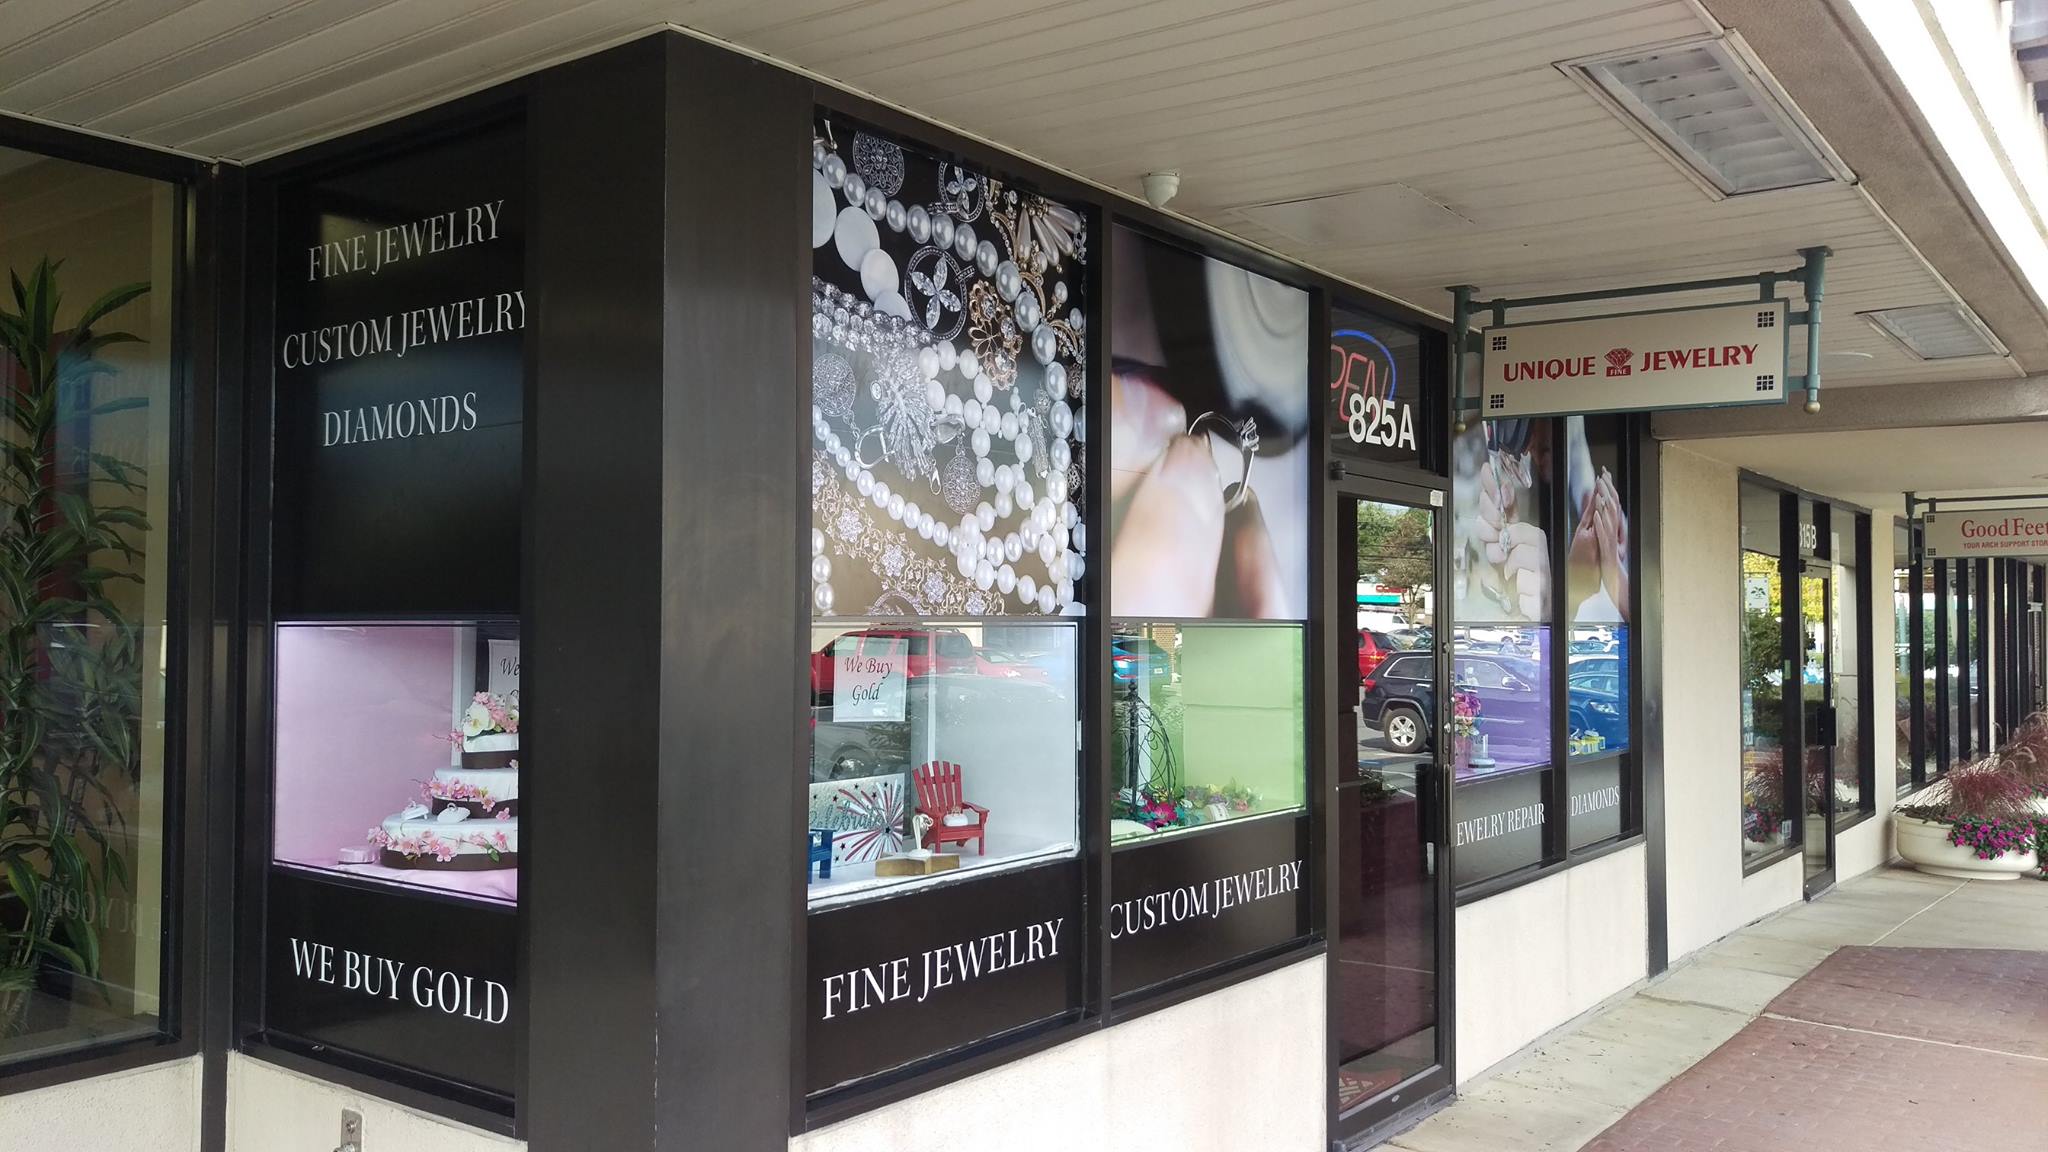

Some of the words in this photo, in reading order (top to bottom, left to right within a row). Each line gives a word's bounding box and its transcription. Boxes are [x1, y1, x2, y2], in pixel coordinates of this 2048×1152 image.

[308, 235, 367, 282] FINE
[371, 200, 504, 276] JEWELRY
[283, 315, 393, 369] CUSTOM
[397, 290, 527, 358] JEWELRY
[1331, 344, 1389, 421] PEN
[1503, 356, 1596, 382] UNIQUE
[1640, 344, 1759, 372] JEWELRY
[322, 391, 477, 447] DIAMONDS
[1348, 393, 1416, 451] 825A
[1961, 519, 2009, 538] Good
[2000, 540, 2029, 548] SUPPORT
[2031, 539, 2048, 547] STOR
[501, 656, 520, 676] We
[844, 656, 863, 673] We
[865, 657, 893, 680] Buy
[852, 682, 884, 706] Gold
[1456, 812, 1506, 847] EWELRY
[1507, 802, 1545, 833] REPAIR
[1571, 785, 1619, 817] DIAMONDS
[1111, 882, 1209, 939] CUSTOM
[1212, 860, 1303, 919] JEWELRY
[290, 938, 335, 985] WE
[344, 950, 404, 1001] BUY
[412, 966, 509, 1024] GOLD
[822, 957, 911, 1020] FINE
[918, 918, 1064, 1002] JEWELRY
